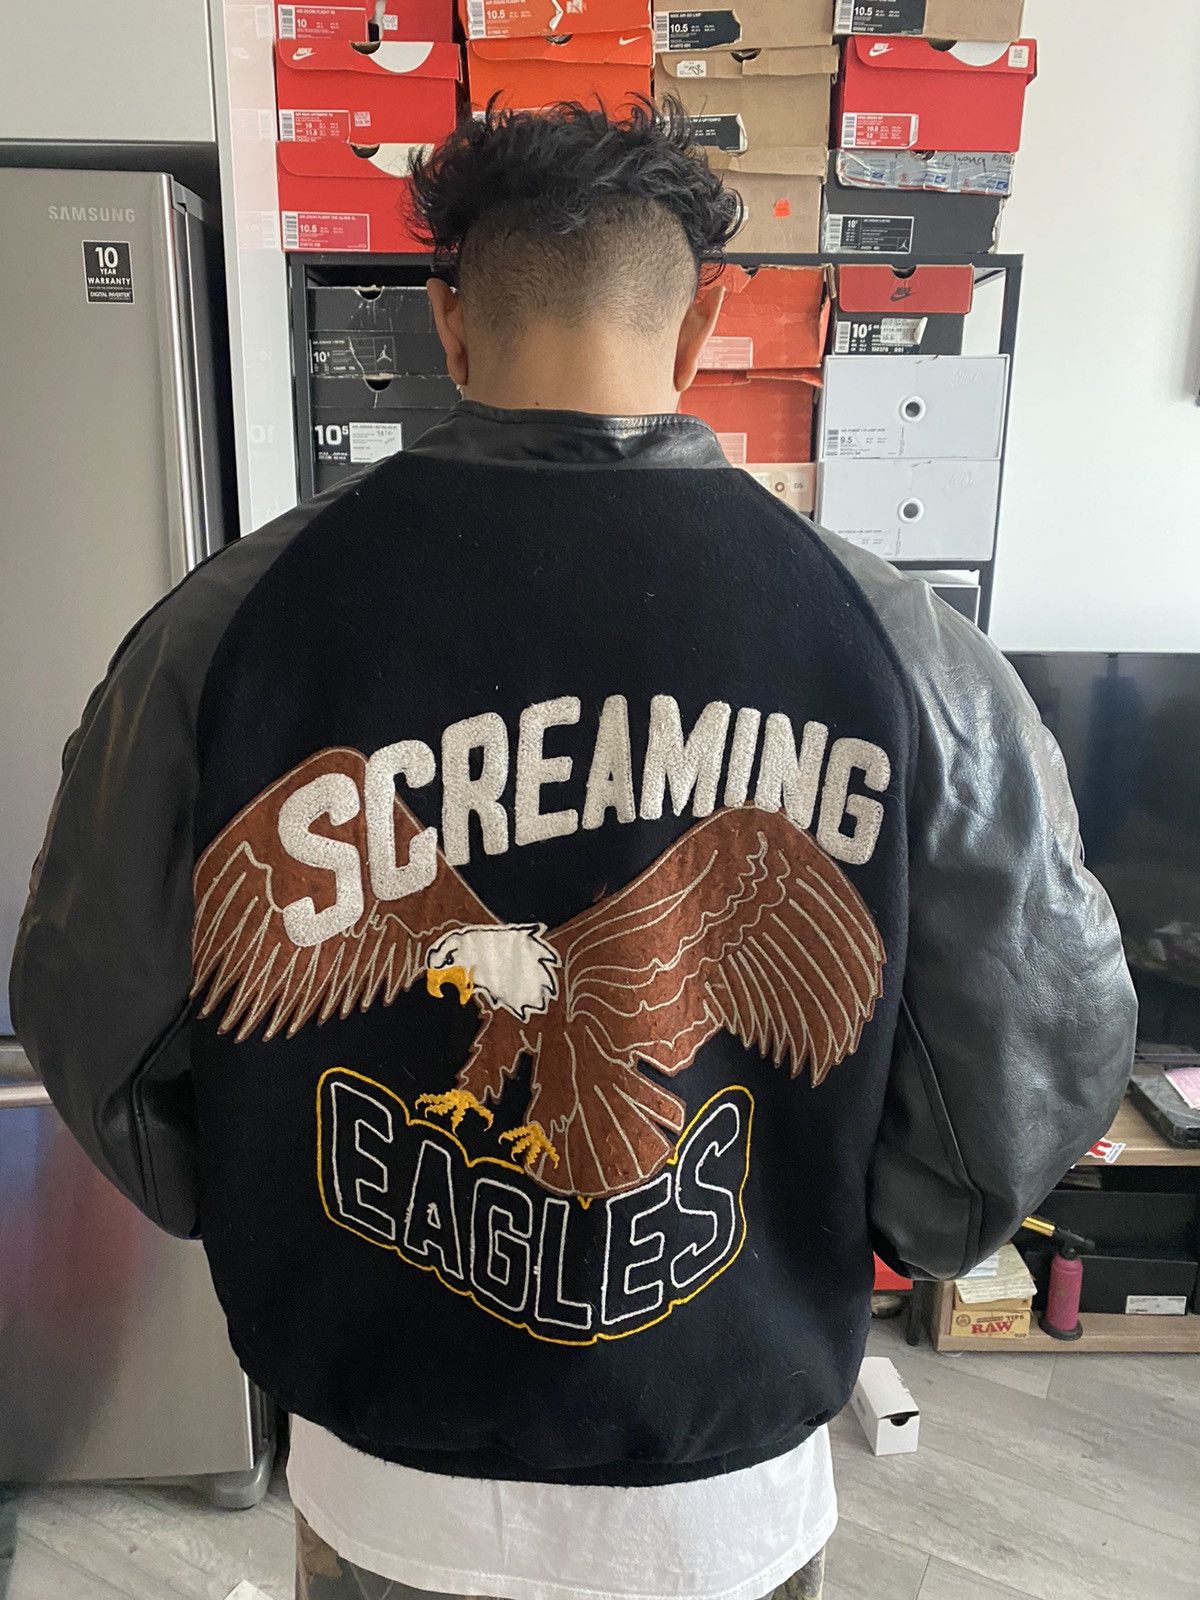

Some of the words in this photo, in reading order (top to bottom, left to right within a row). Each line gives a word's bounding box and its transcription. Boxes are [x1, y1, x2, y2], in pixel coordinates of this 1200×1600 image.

[487, 10, 505, 19] 10.5
[854, 7, 873, 16] 10.5
[296, 19, 307, 28] 10
[670, 24, 688, 33] 10.5
[48, 206, 136, 223] SAMSUNG
[300, 224, 317, 233] 10.5
[95, 246, 118, 268] 10
[87, 277, 131, 285] WARRANTY
[278, 695, 891, 948] SCREAMING
[329, 1082, 741, 1329] EAGLES
[971, 1321, 1013, 1334] RAW
